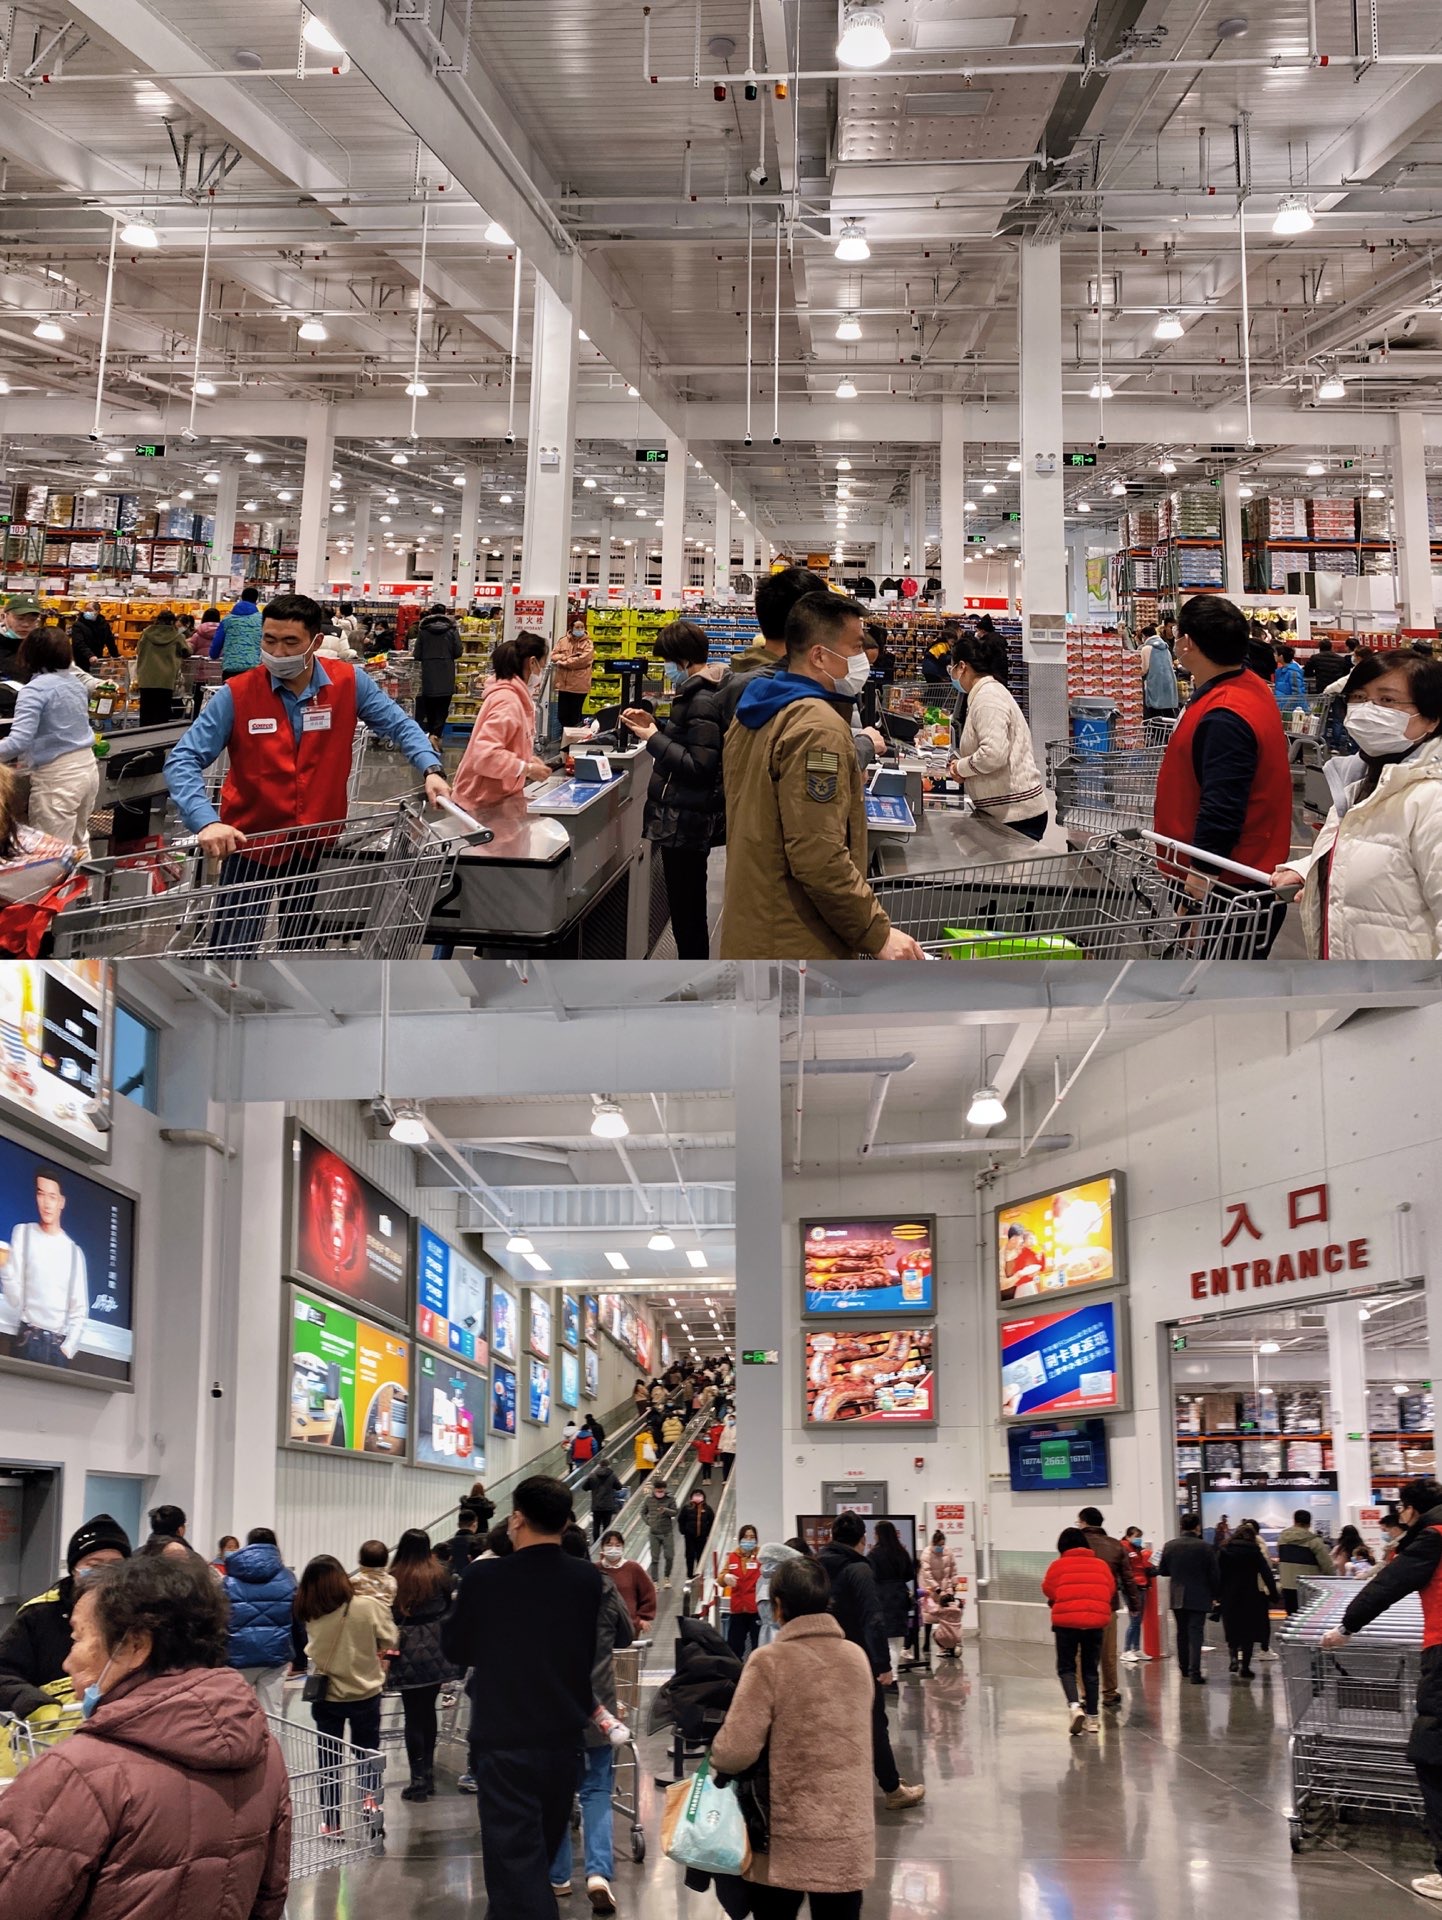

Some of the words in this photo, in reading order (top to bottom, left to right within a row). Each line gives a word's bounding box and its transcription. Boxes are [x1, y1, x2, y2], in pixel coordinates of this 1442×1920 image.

[11, 526, 25, 534] 103
[1152, 548, 1167, 556] 205
[1111, 557, 1124, 565] 207
[515, 616, 544, 625] 消火栓
[1220, 1183, 1328, 1248] 入口
[1190, 1238, 1370, 1300] ENTRANCE
[688, 1778, 705, 1815] STARBUCKS
